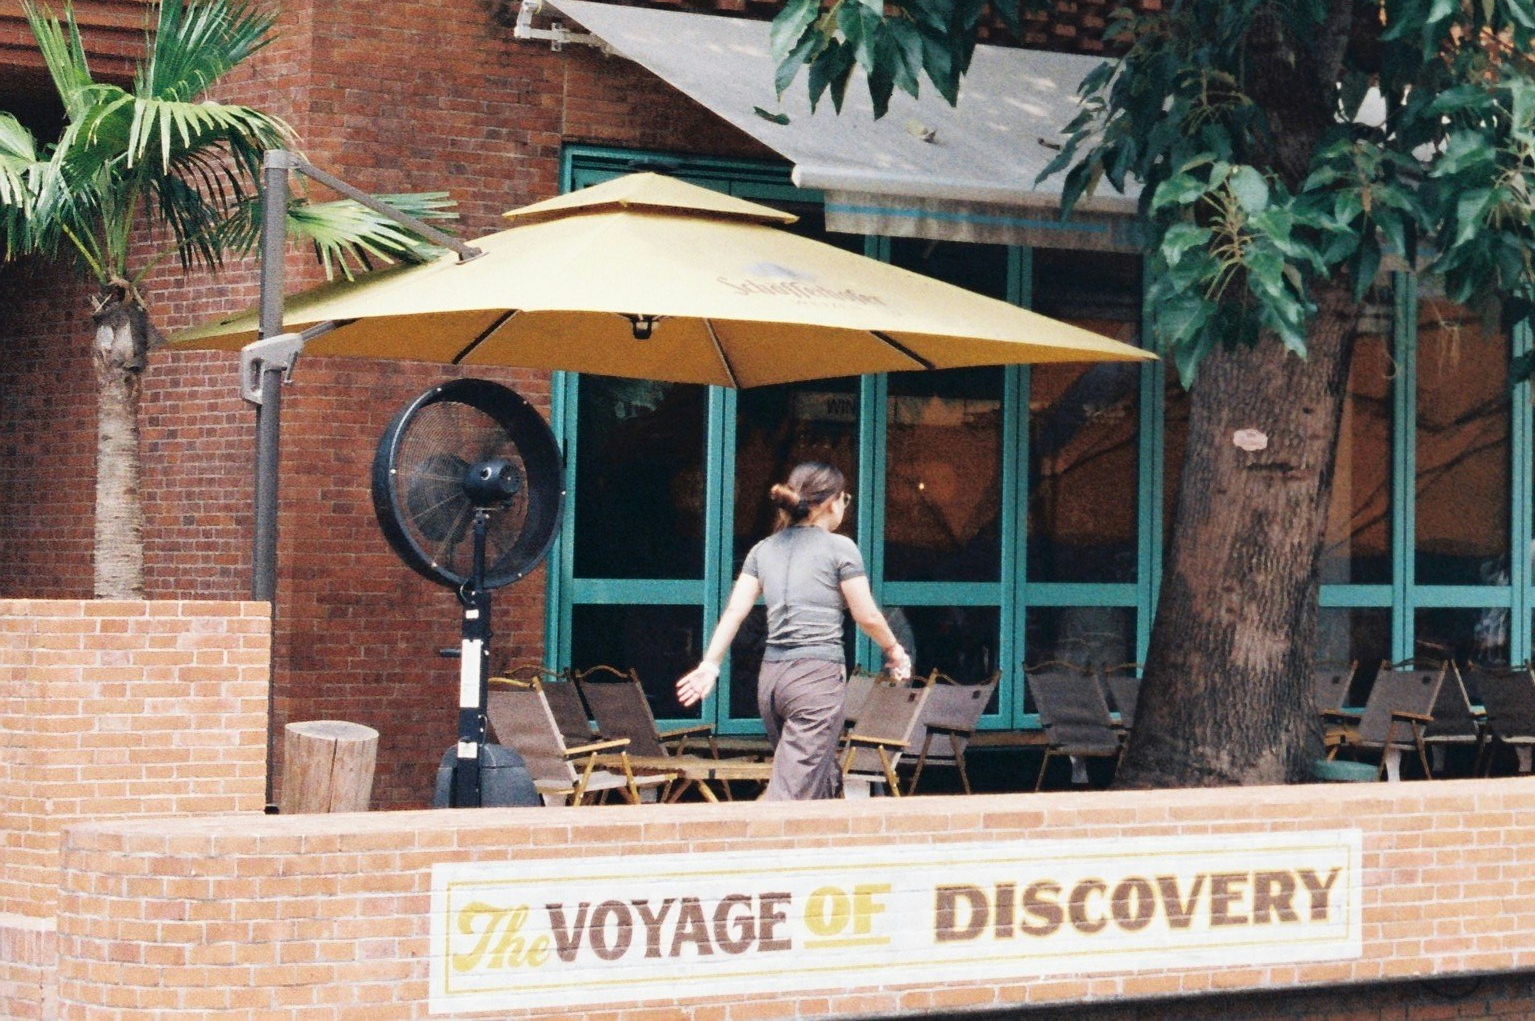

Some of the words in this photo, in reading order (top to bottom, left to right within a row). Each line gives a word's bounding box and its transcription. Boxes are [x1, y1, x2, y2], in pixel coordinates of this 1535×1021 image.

[452, 901, 550, 973] The
[545, 891, 792, 963] VOYAGE
[805, 883, 892, 940] OF
[934, 866, 1343, 944] DISCOVERY
